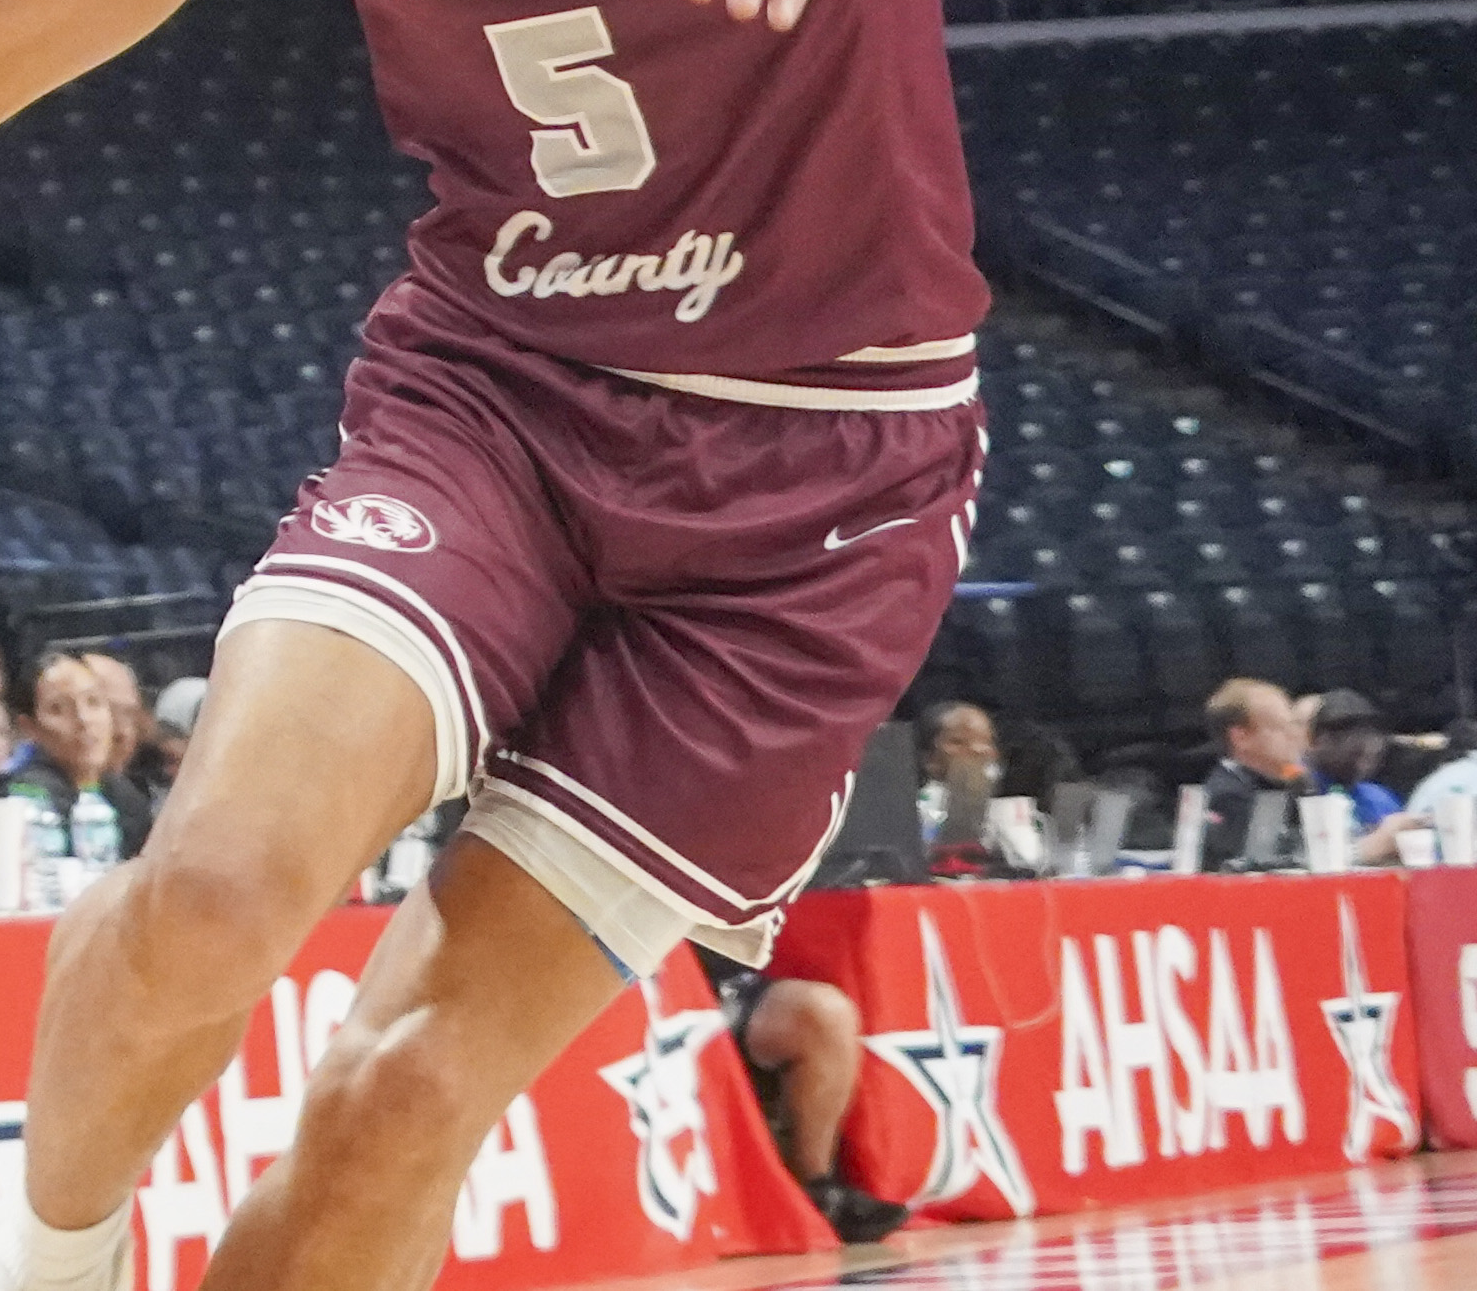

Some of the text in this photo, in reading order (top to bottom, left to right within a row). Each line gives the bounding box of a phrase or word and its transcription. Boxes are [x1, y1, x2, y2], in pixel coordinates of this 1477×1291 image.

[484, 6, 656, 198] 5
[484, 211, 743, 323] County
[1053, 924, 1306, 1175] AHSAA
